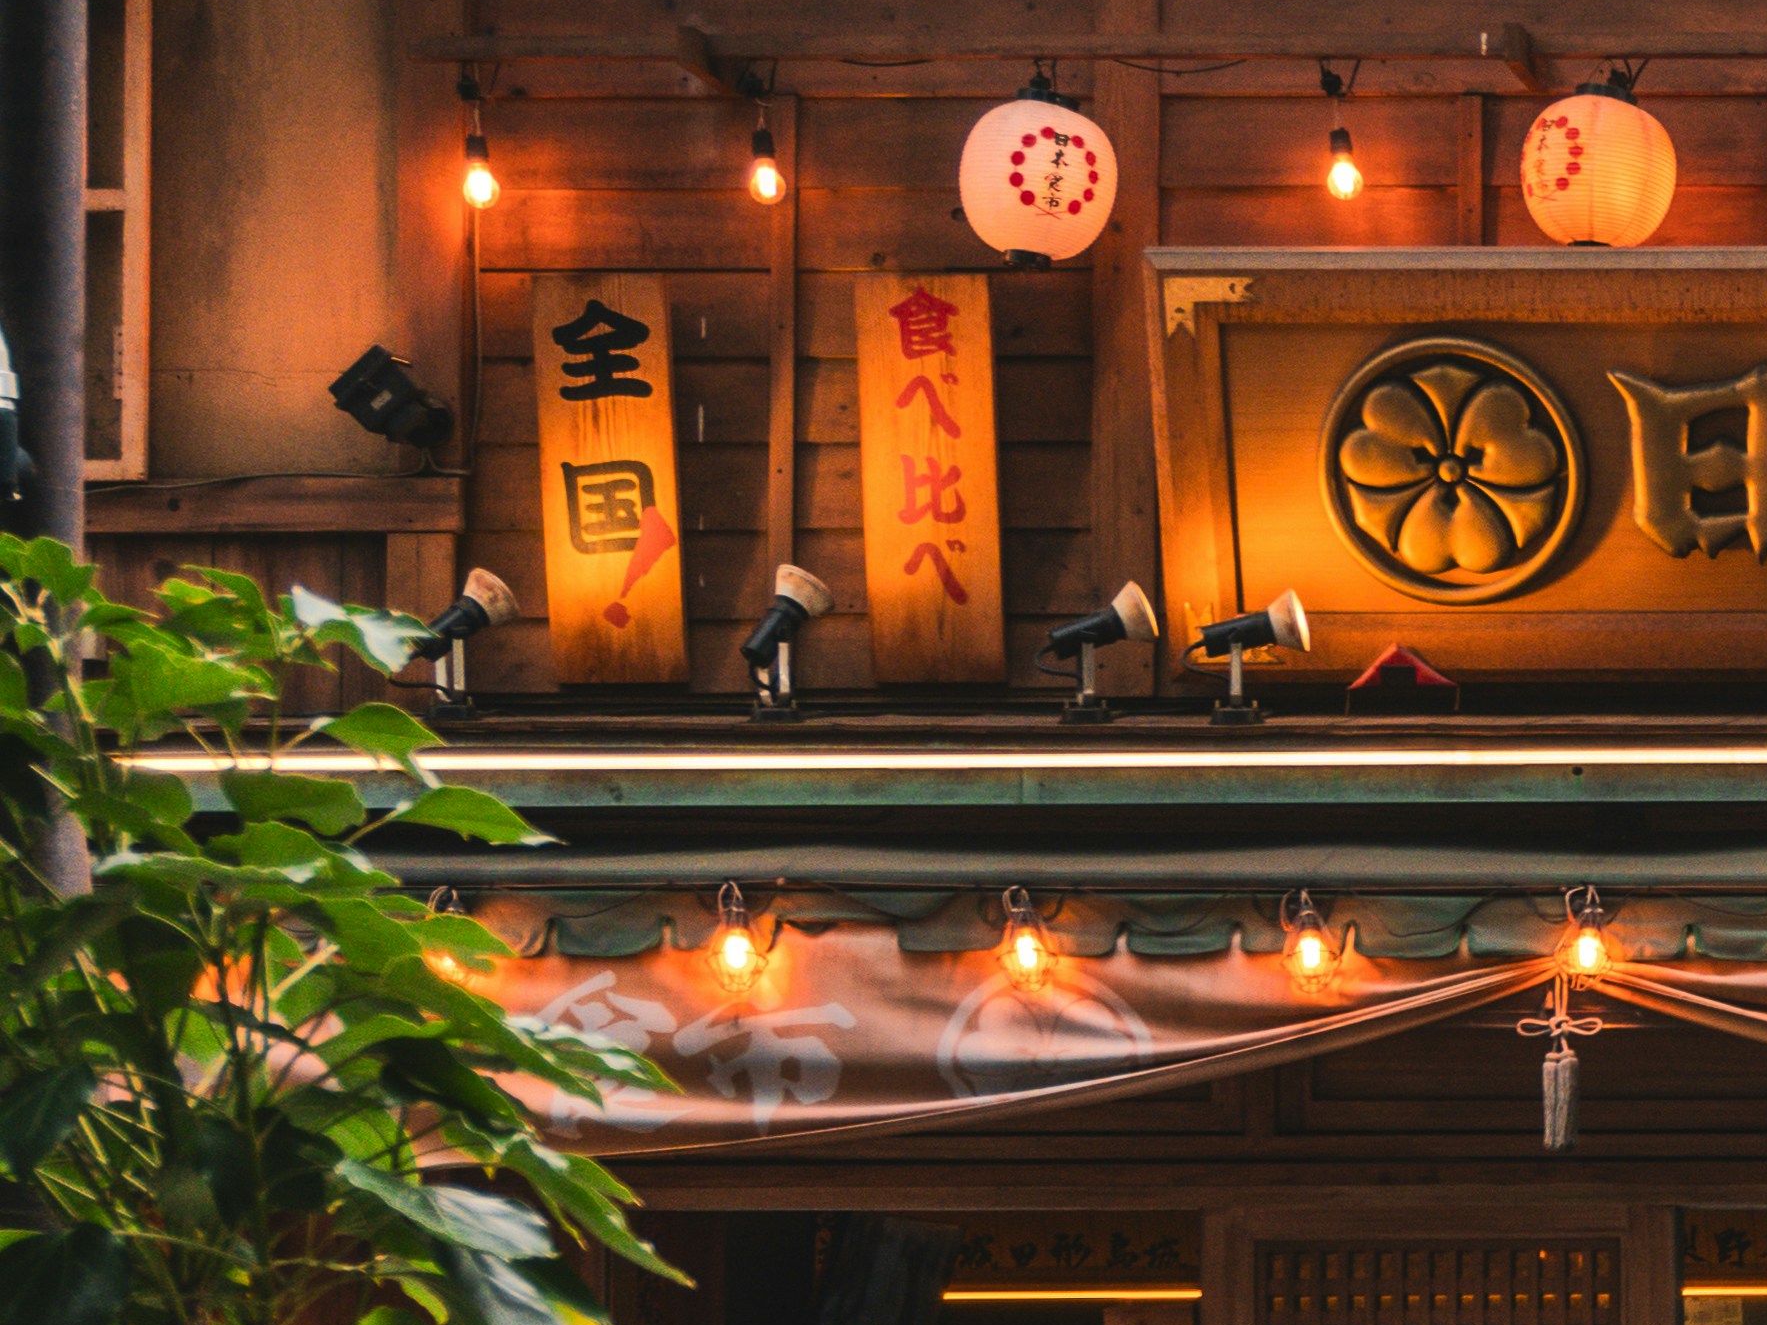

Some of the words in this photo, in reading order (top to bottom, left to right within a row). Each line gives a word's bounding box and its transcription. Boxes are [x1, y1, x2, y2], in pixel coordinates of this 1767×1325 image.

[1043, 132, 1070, 208] 日本食市
[887, 286, 968, 604] 食べ比べ
